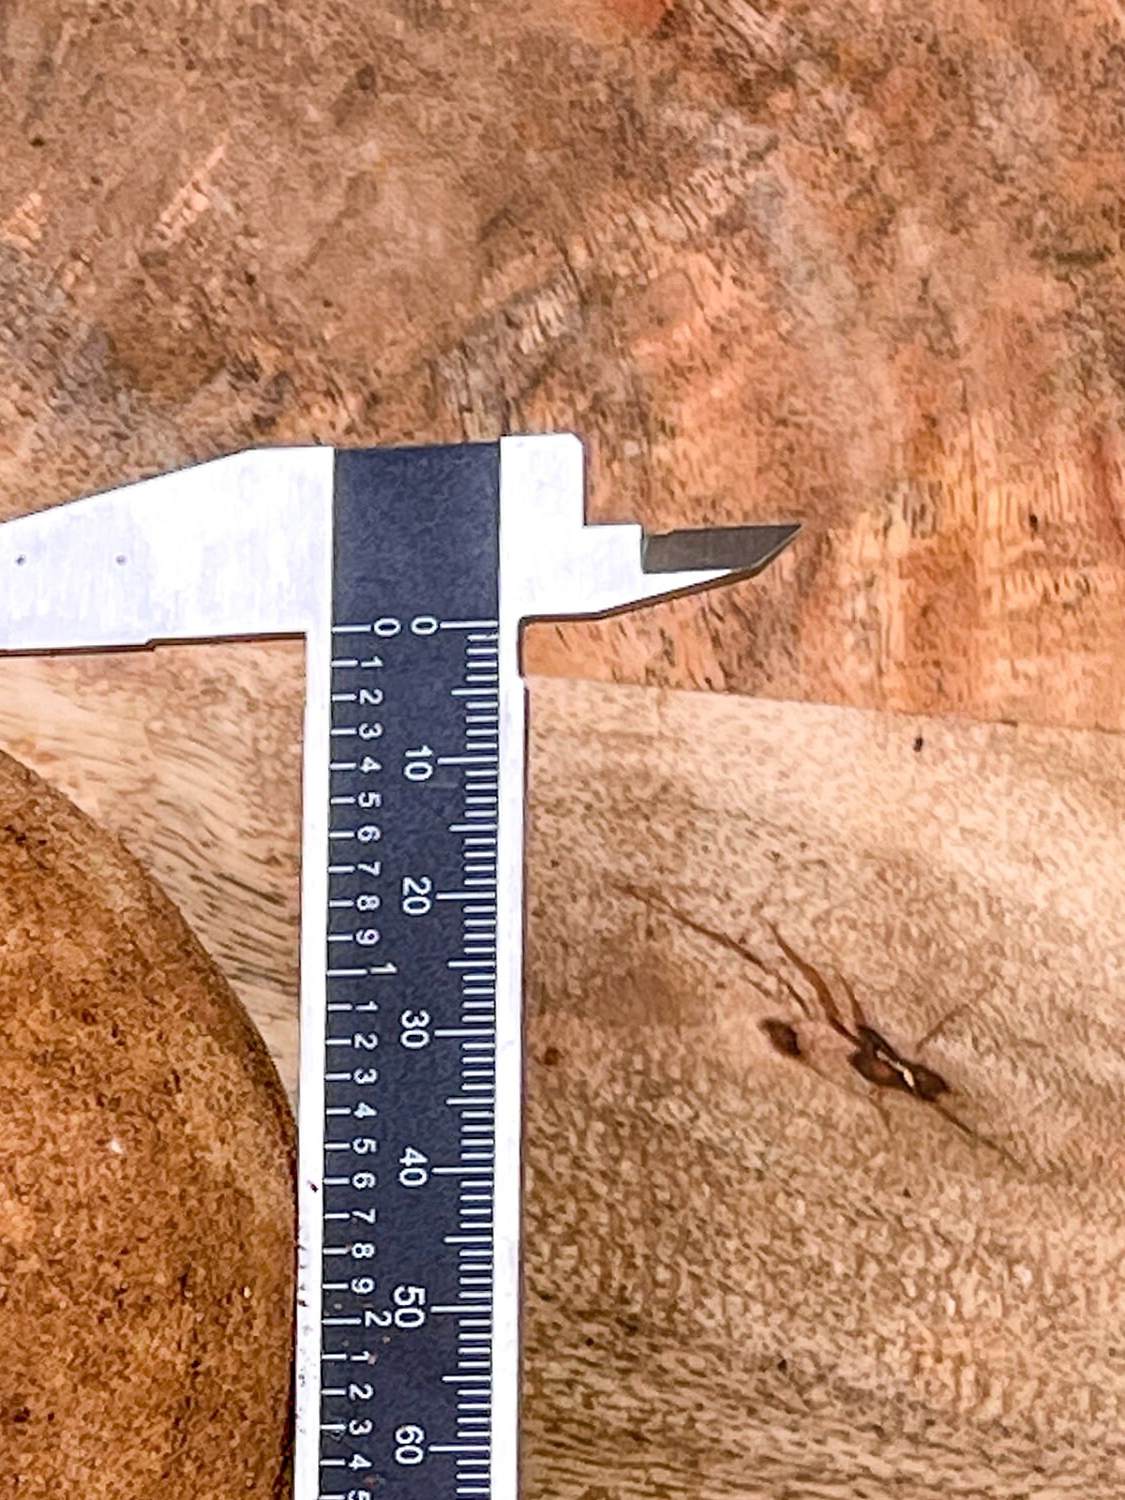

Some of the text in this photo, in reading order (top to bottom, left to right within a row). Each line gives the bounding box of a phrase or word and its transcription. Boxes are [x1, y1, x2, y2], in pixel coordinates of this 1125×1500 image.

[373, 617, 401, 637] 0
[410, 616, 439, 635] 0
[359, 688, 383, 705] 2
[358, 722, 383, 740] 3
[359, 756, 382, 773] 4
[403, 744, 434, 781] 10
[357, 791, 382, 808] 5
[357, 825, 381, 843] 6
[357, 861, 381, 876] 7
[356, 895, 380, 911] 8
[402, 876, 432, 915] 20
[355, 929, 380, 945] 9
[400, 1009, 430, 1049] 30
[354, 1033, 378, 1050] 2
[353, 1068, 378, 1085] 3
[353, 1102, 377, 1119] 4
[352, 1138, 377, 1154] 5
[398, 1146, 428, 1187] 40
[352, 1172, 376, 1190] 6
[351, 1208, 376, 1224] 7
[350, 1242, 375, 1259] 8
[351, 1277, 375, 1294] 9
[393, 1285, 426, 1328] 50
[364, 1310, 393, 1327] 2
[349, 1383, 374, 1400] 2
[348, 1419, 373, 1436] 3
[395, 1425, 425, 1465] 60
[348, 1453, 372, 1470] 4
